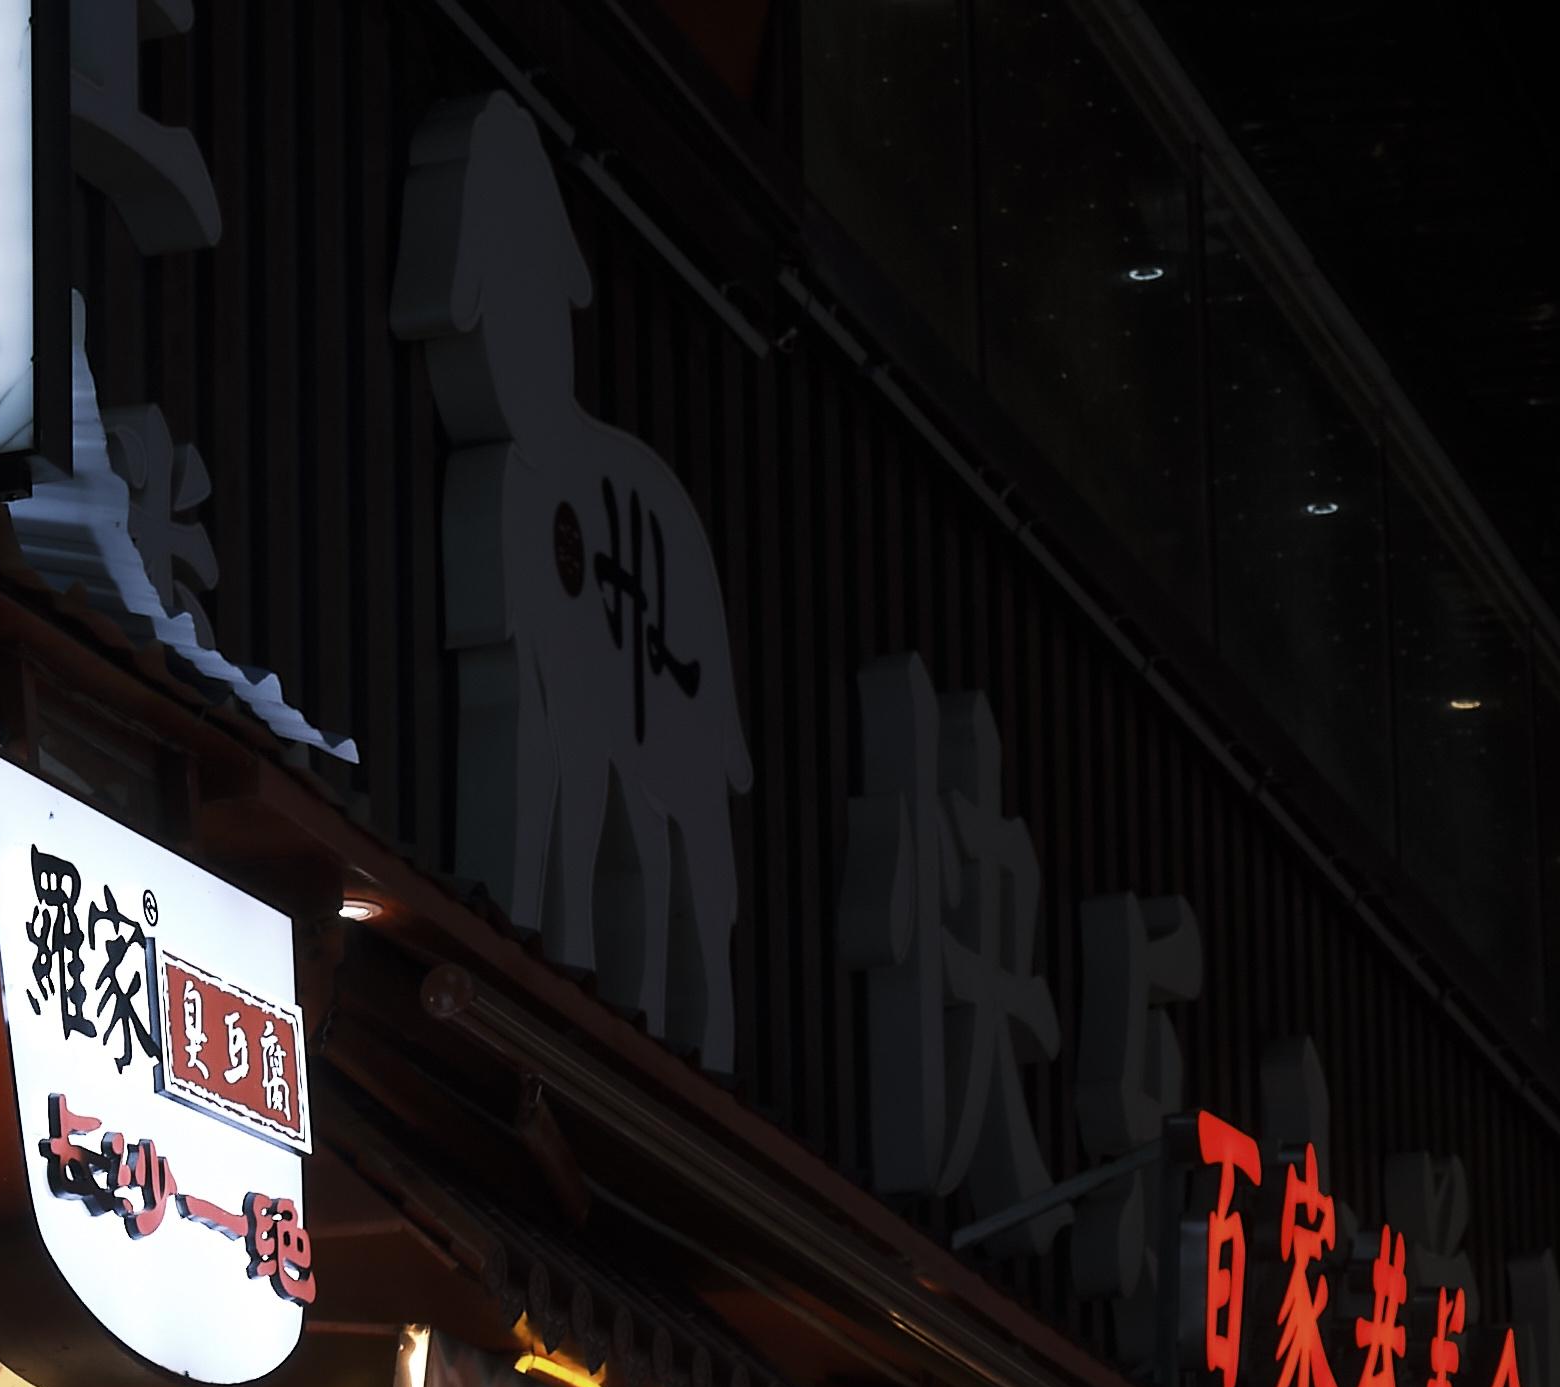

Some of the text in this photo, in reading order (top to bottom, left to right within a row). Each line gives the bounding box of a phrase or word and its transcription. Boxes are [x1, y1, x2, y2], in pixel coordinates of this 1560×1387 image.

[25, 843, 160, 1074] 羅家
[182, 981, 292, 1121] 臭豆腐
[38, 1093, 316, 1307] 长沙一绝
